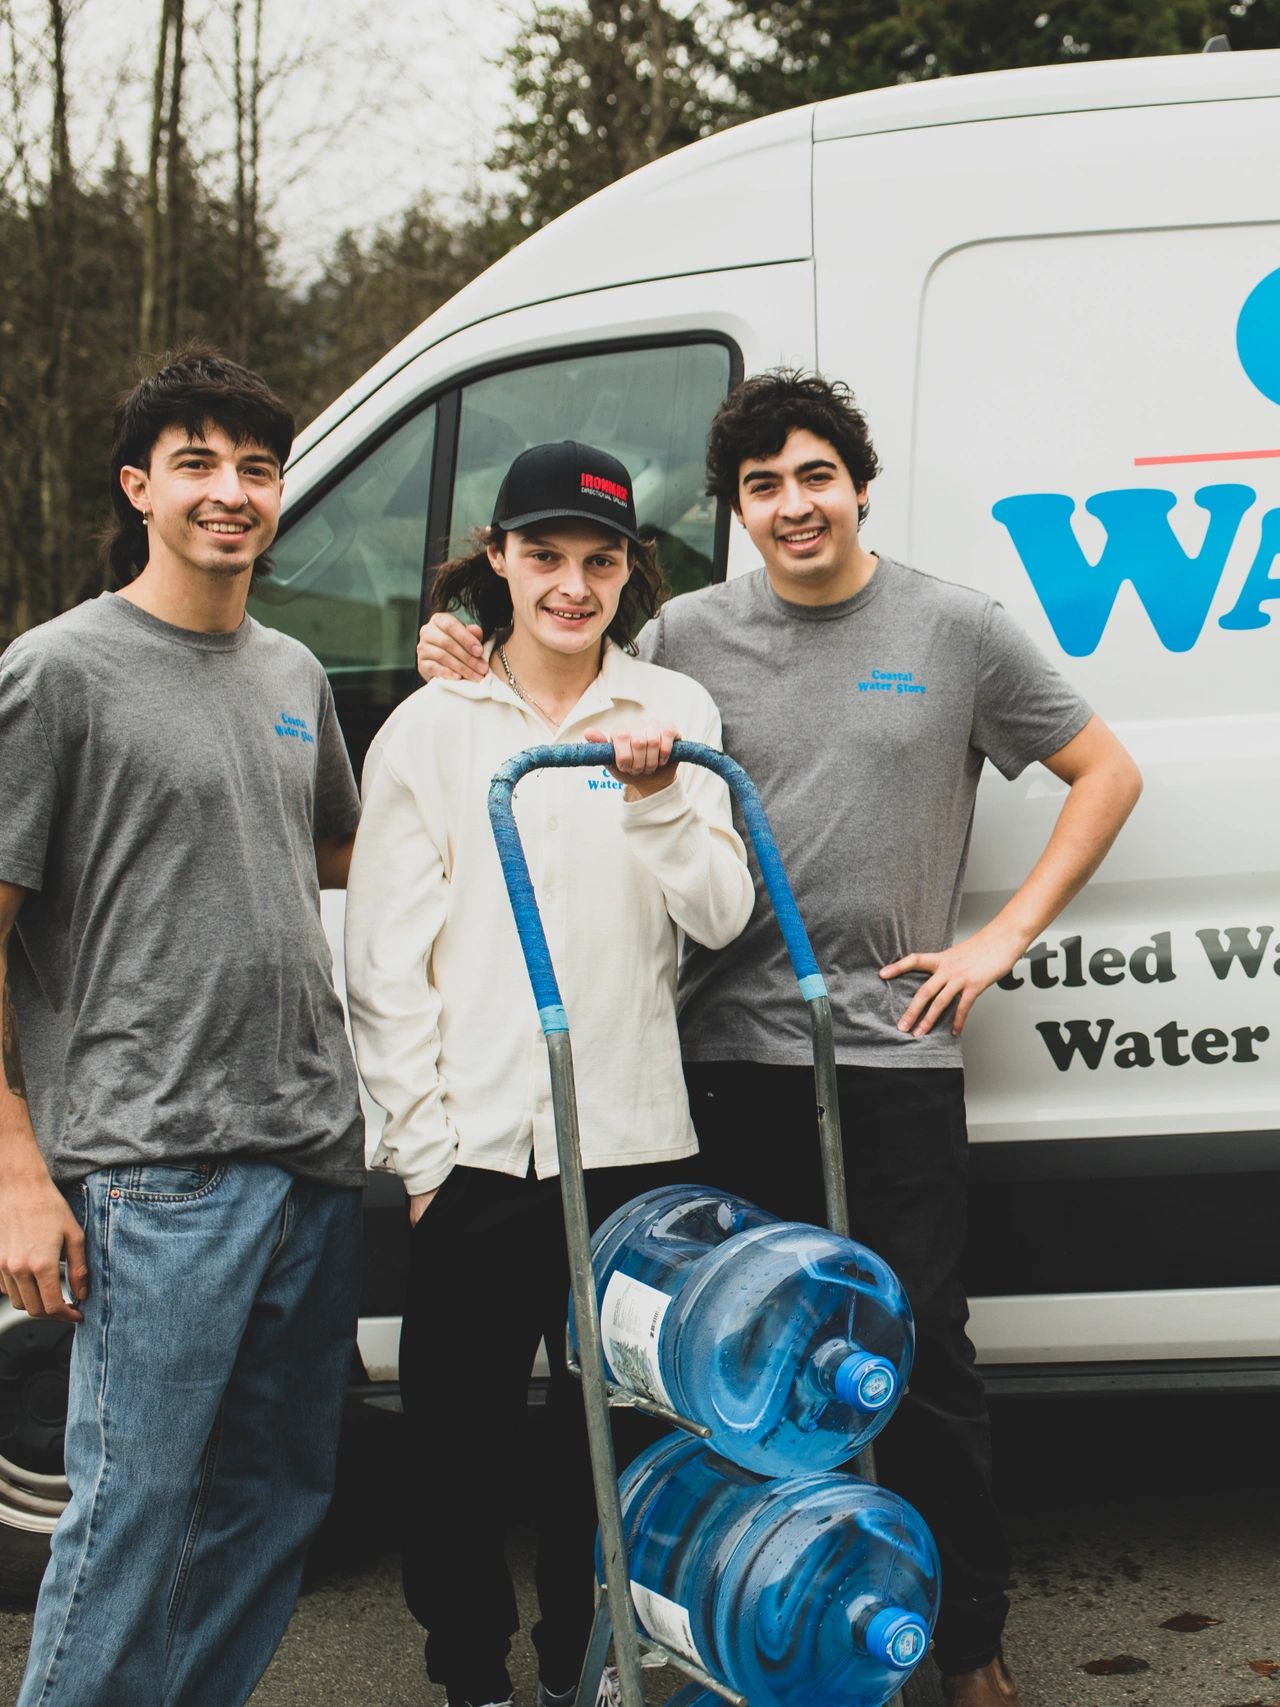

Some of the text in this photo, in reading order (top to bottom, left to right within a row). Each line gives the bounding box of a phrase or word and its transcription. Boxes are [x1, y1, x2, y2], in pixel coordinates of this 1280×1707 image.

[872, 669, 912, 682] Coastal
[857, 681, 927, 695] Water Store
[588, 780, 623, 790] Water
[1035, 1018, 1270, 1073] Water
